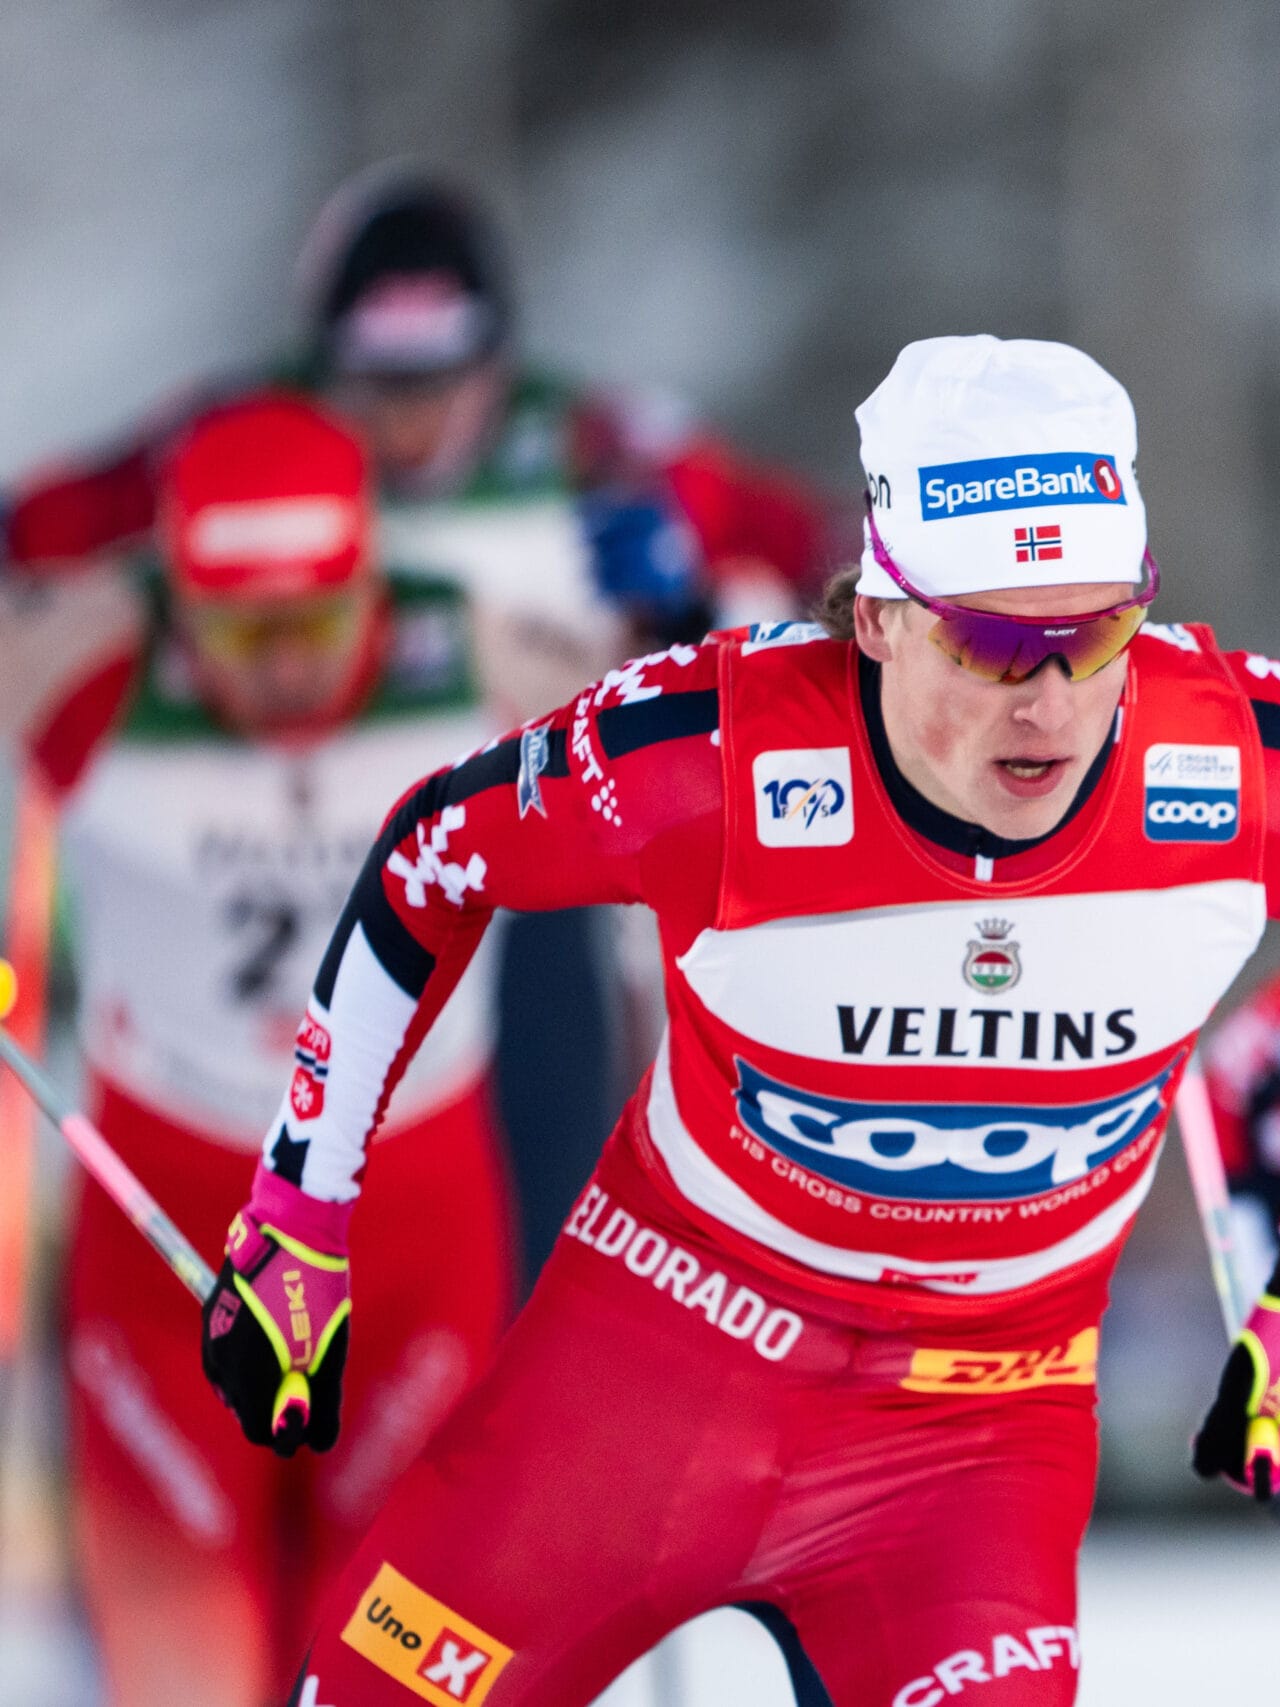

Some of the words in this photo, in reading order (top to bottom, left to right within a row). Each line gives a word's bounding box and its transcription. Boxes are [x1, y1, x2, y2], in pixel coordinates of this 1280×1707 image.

[925, 464, 1095, 514] SpareBank
[571, 682, 604, 784] RAFT
[1177, 754, 1219, 764] CROSS
[1177, 764, 1235, 774] COUNTRY
[1147, 800, 1237, 829] coop
[836, 1004, 1139, 1061] VELTINS
[729, 1124, 765, 1161] FIS
[770, 1156, 862, 1224] CROSS
[869, 1202, 1012, 1223] COUNTRY
[1018, 1169, 1110, 1219] WORLD
[1112, 1127, 1157, 1173] CUP
[756, 1086, 1160, 1185] coop
[564, 1183, 804, 1362] ELDORADO
[282, 1270, 312, 1366] LEKI
[941, 1344, 1079, 1384] DHL
[366, 1596, 423, 1651] Uno
[423, 1639, 488, 1698] X
[891, 1624, 1080, 1707] CRAFT
